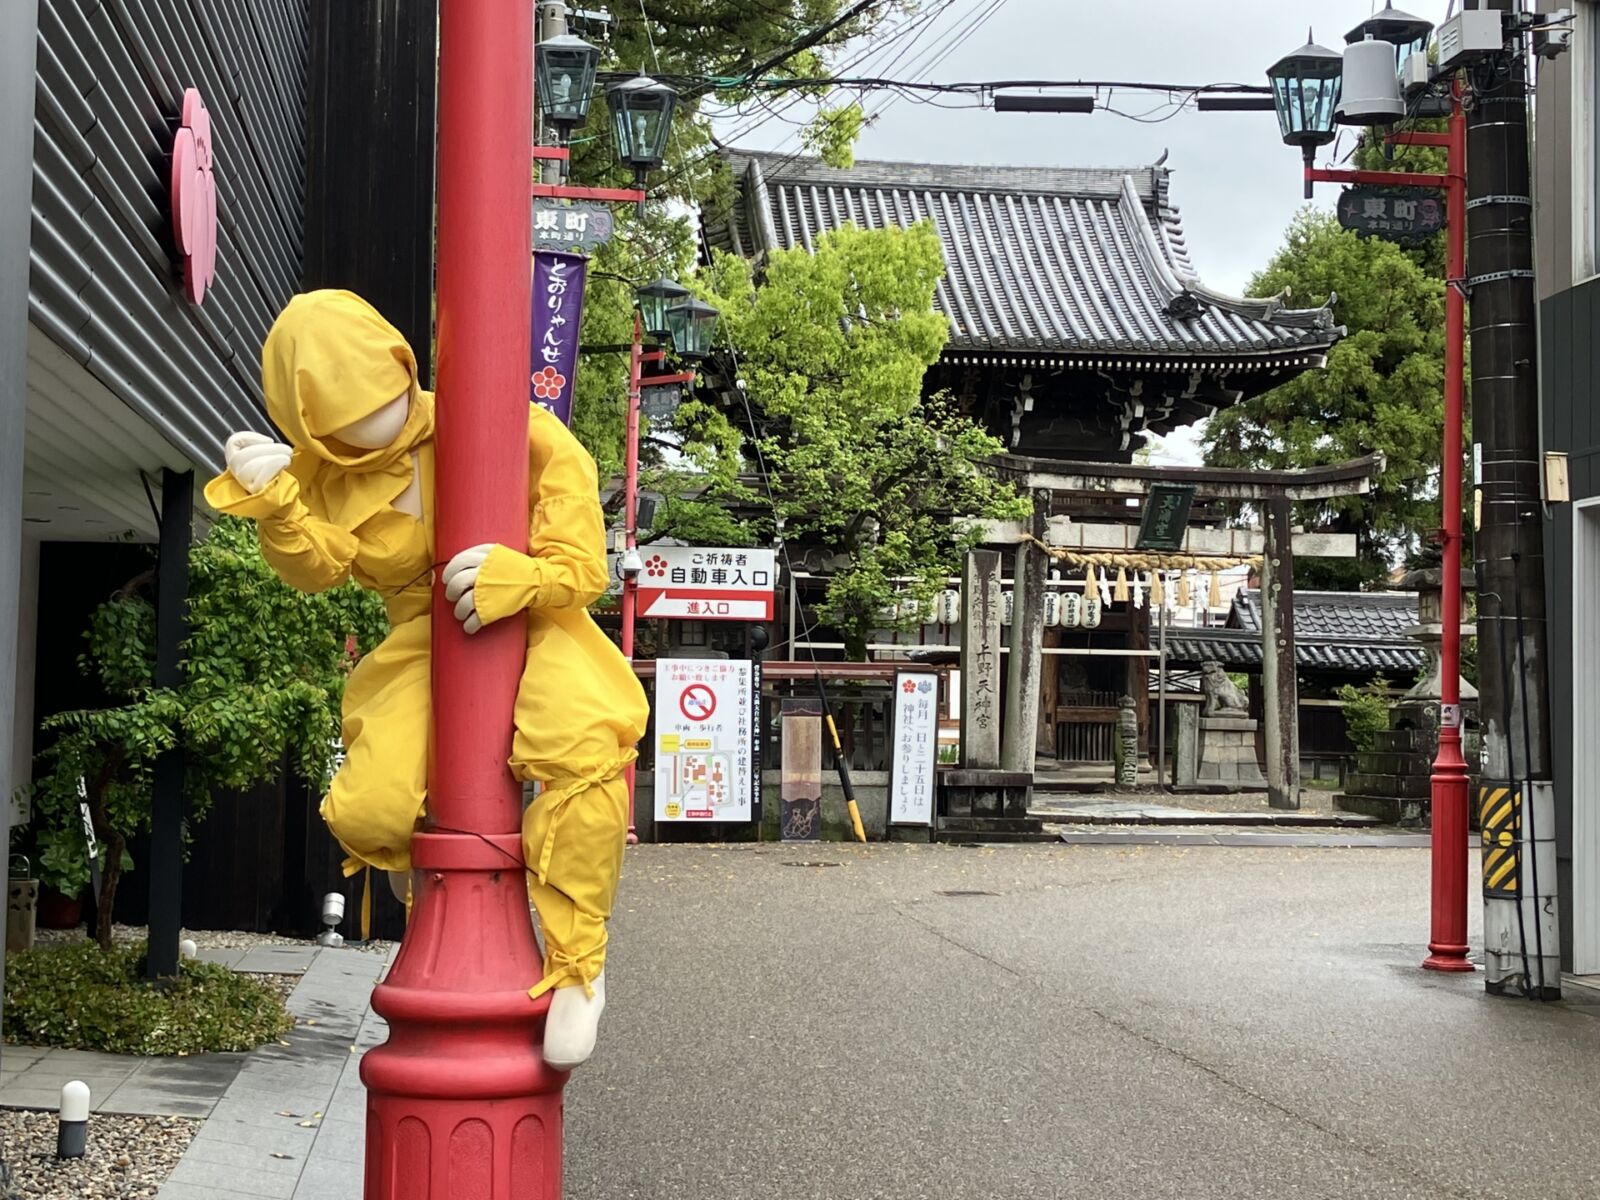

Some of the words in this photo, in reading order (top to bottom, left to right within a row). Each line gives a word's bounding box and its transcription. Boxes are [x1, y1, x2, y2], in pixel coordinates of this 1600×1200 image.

[1361, 198, 1418, 221] 東町
[533, 210, 589, 232] 東町
[1367, 220, 1414, 231] 本町通り
[539, 230, 584, 242] 本町通り
[541, 257, 568, 363] とおりゃんせ
[671, 567, 768, 586] 自動車入口
[687, 601, 730, 614] 進入口
[664, 664, 735, 673] 工事中につきご協力
[900, 703, 915, 814] 神社へお参りしましょう
[914, 698, 928, 807] 毎月一日と二十五日は
